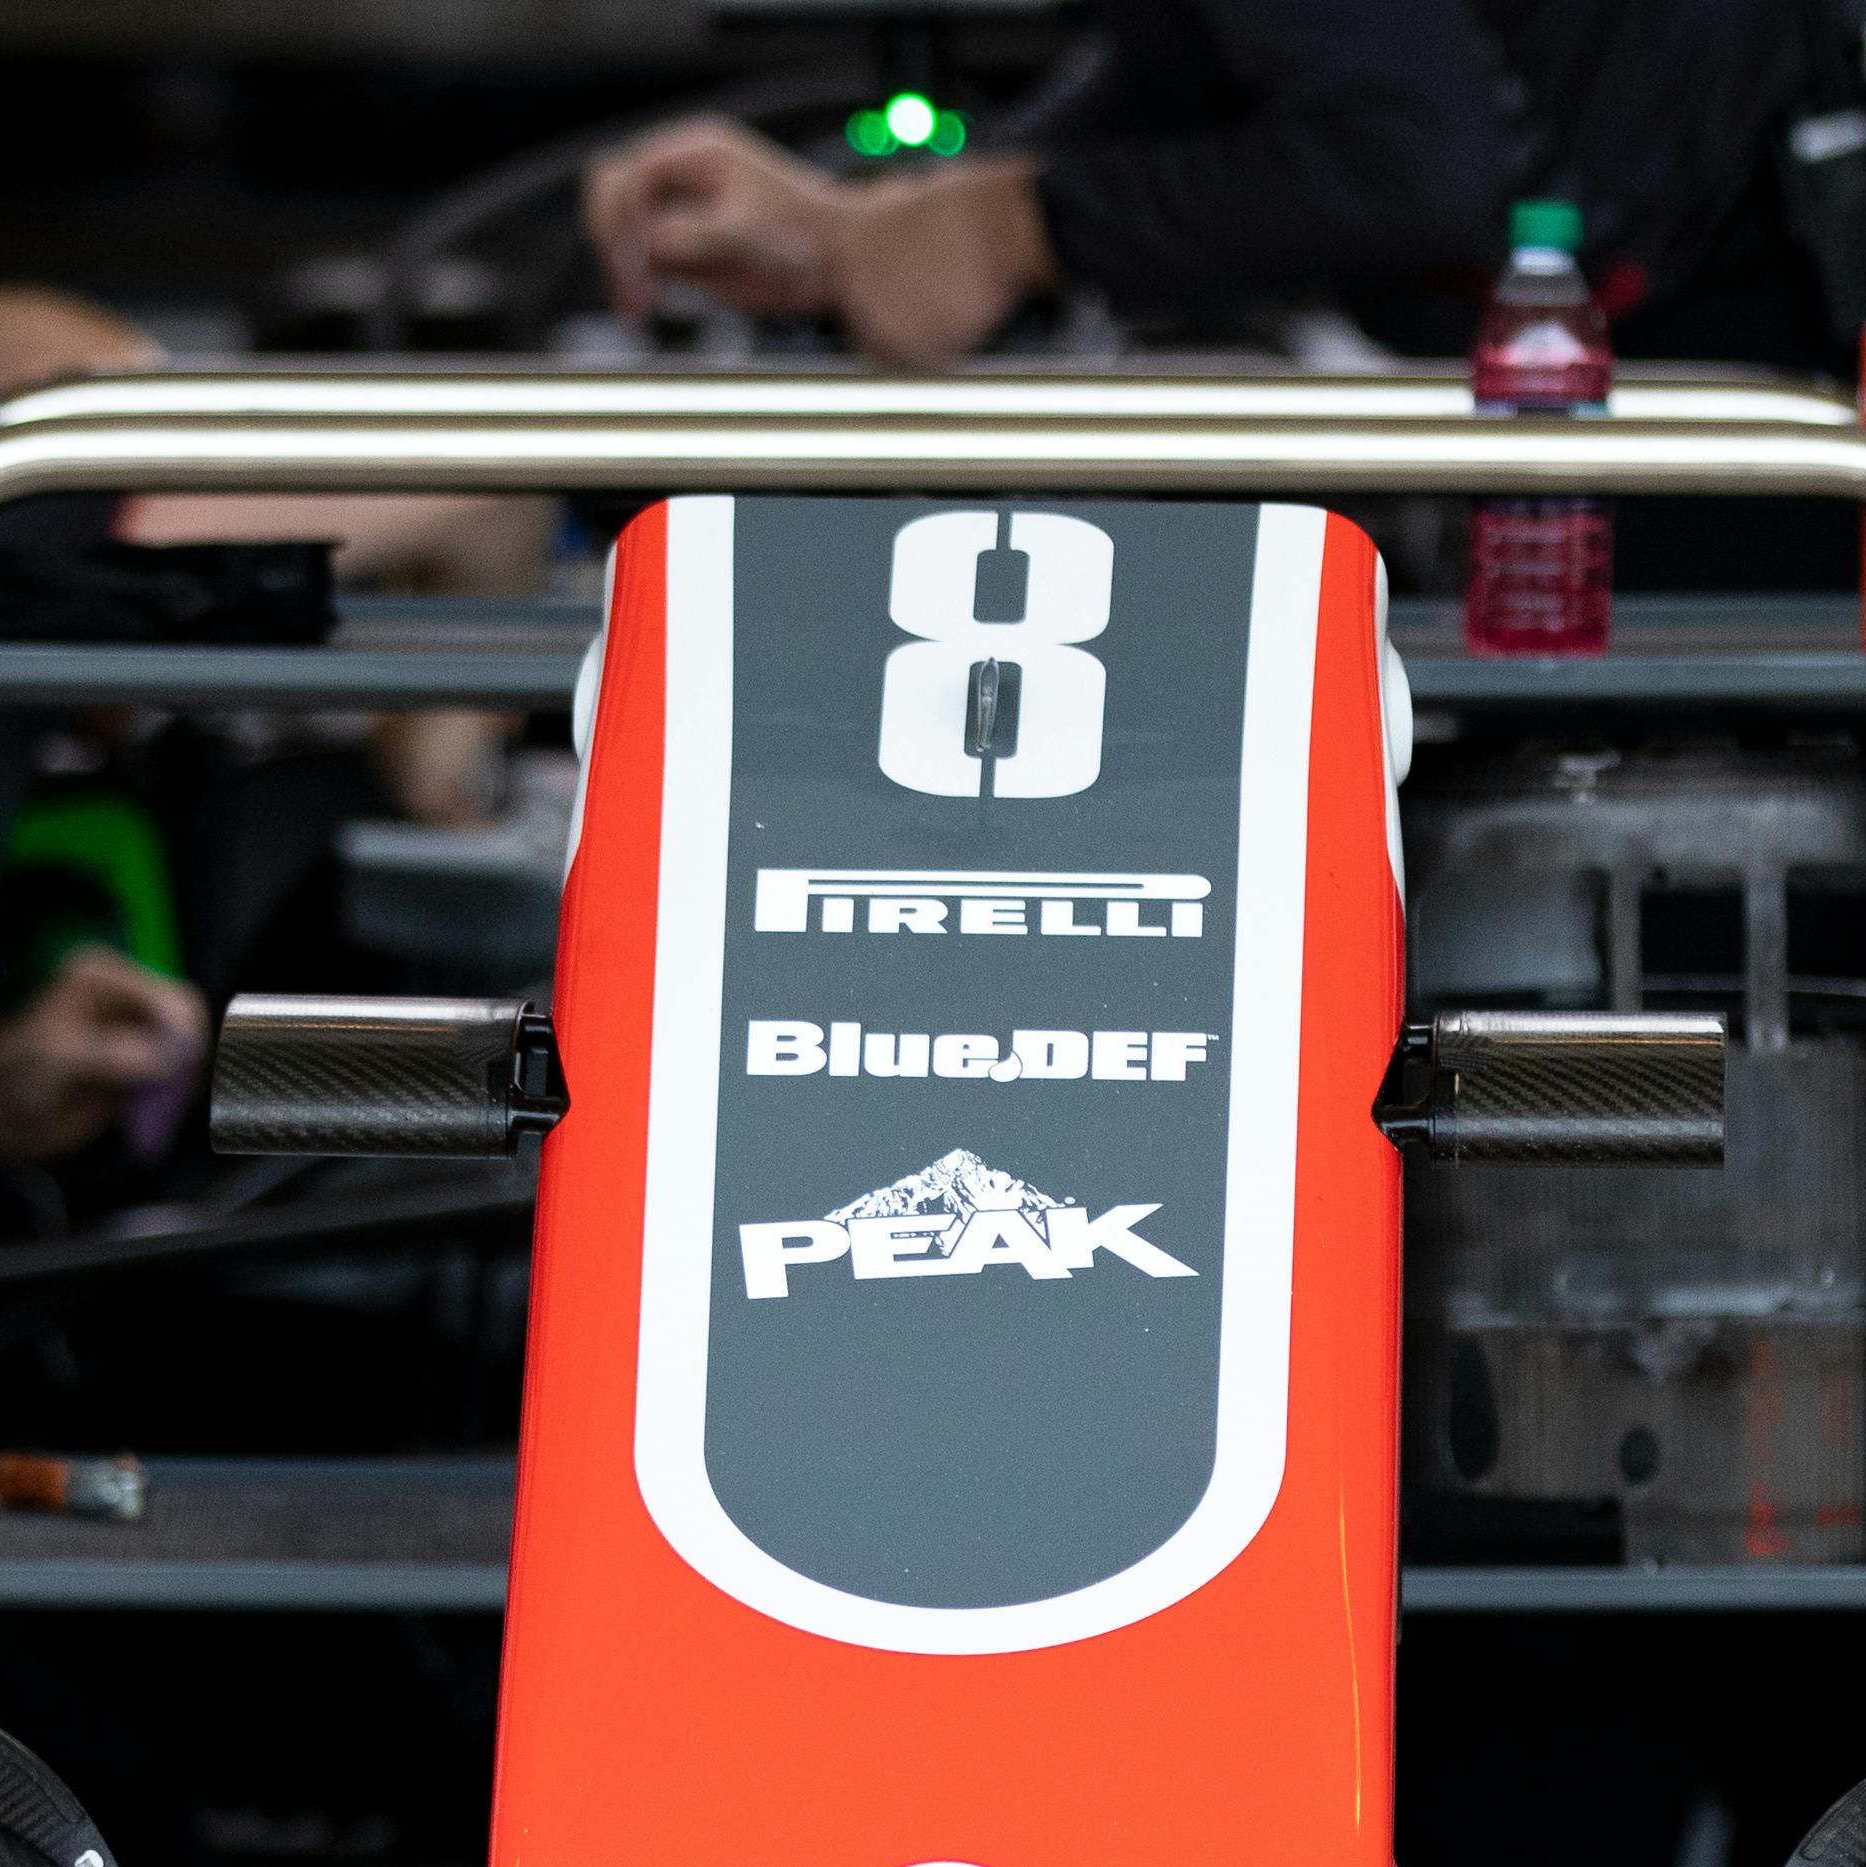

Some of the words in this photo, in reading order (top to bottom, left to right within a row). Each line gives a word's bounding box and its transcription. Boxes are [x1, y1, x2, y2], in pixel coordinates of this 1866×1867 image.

[878, 510, 1115, 799] 8
[754, 868, 1212, 938] PIRELLI
[738, 1203, 1201, 1300] PEAK
